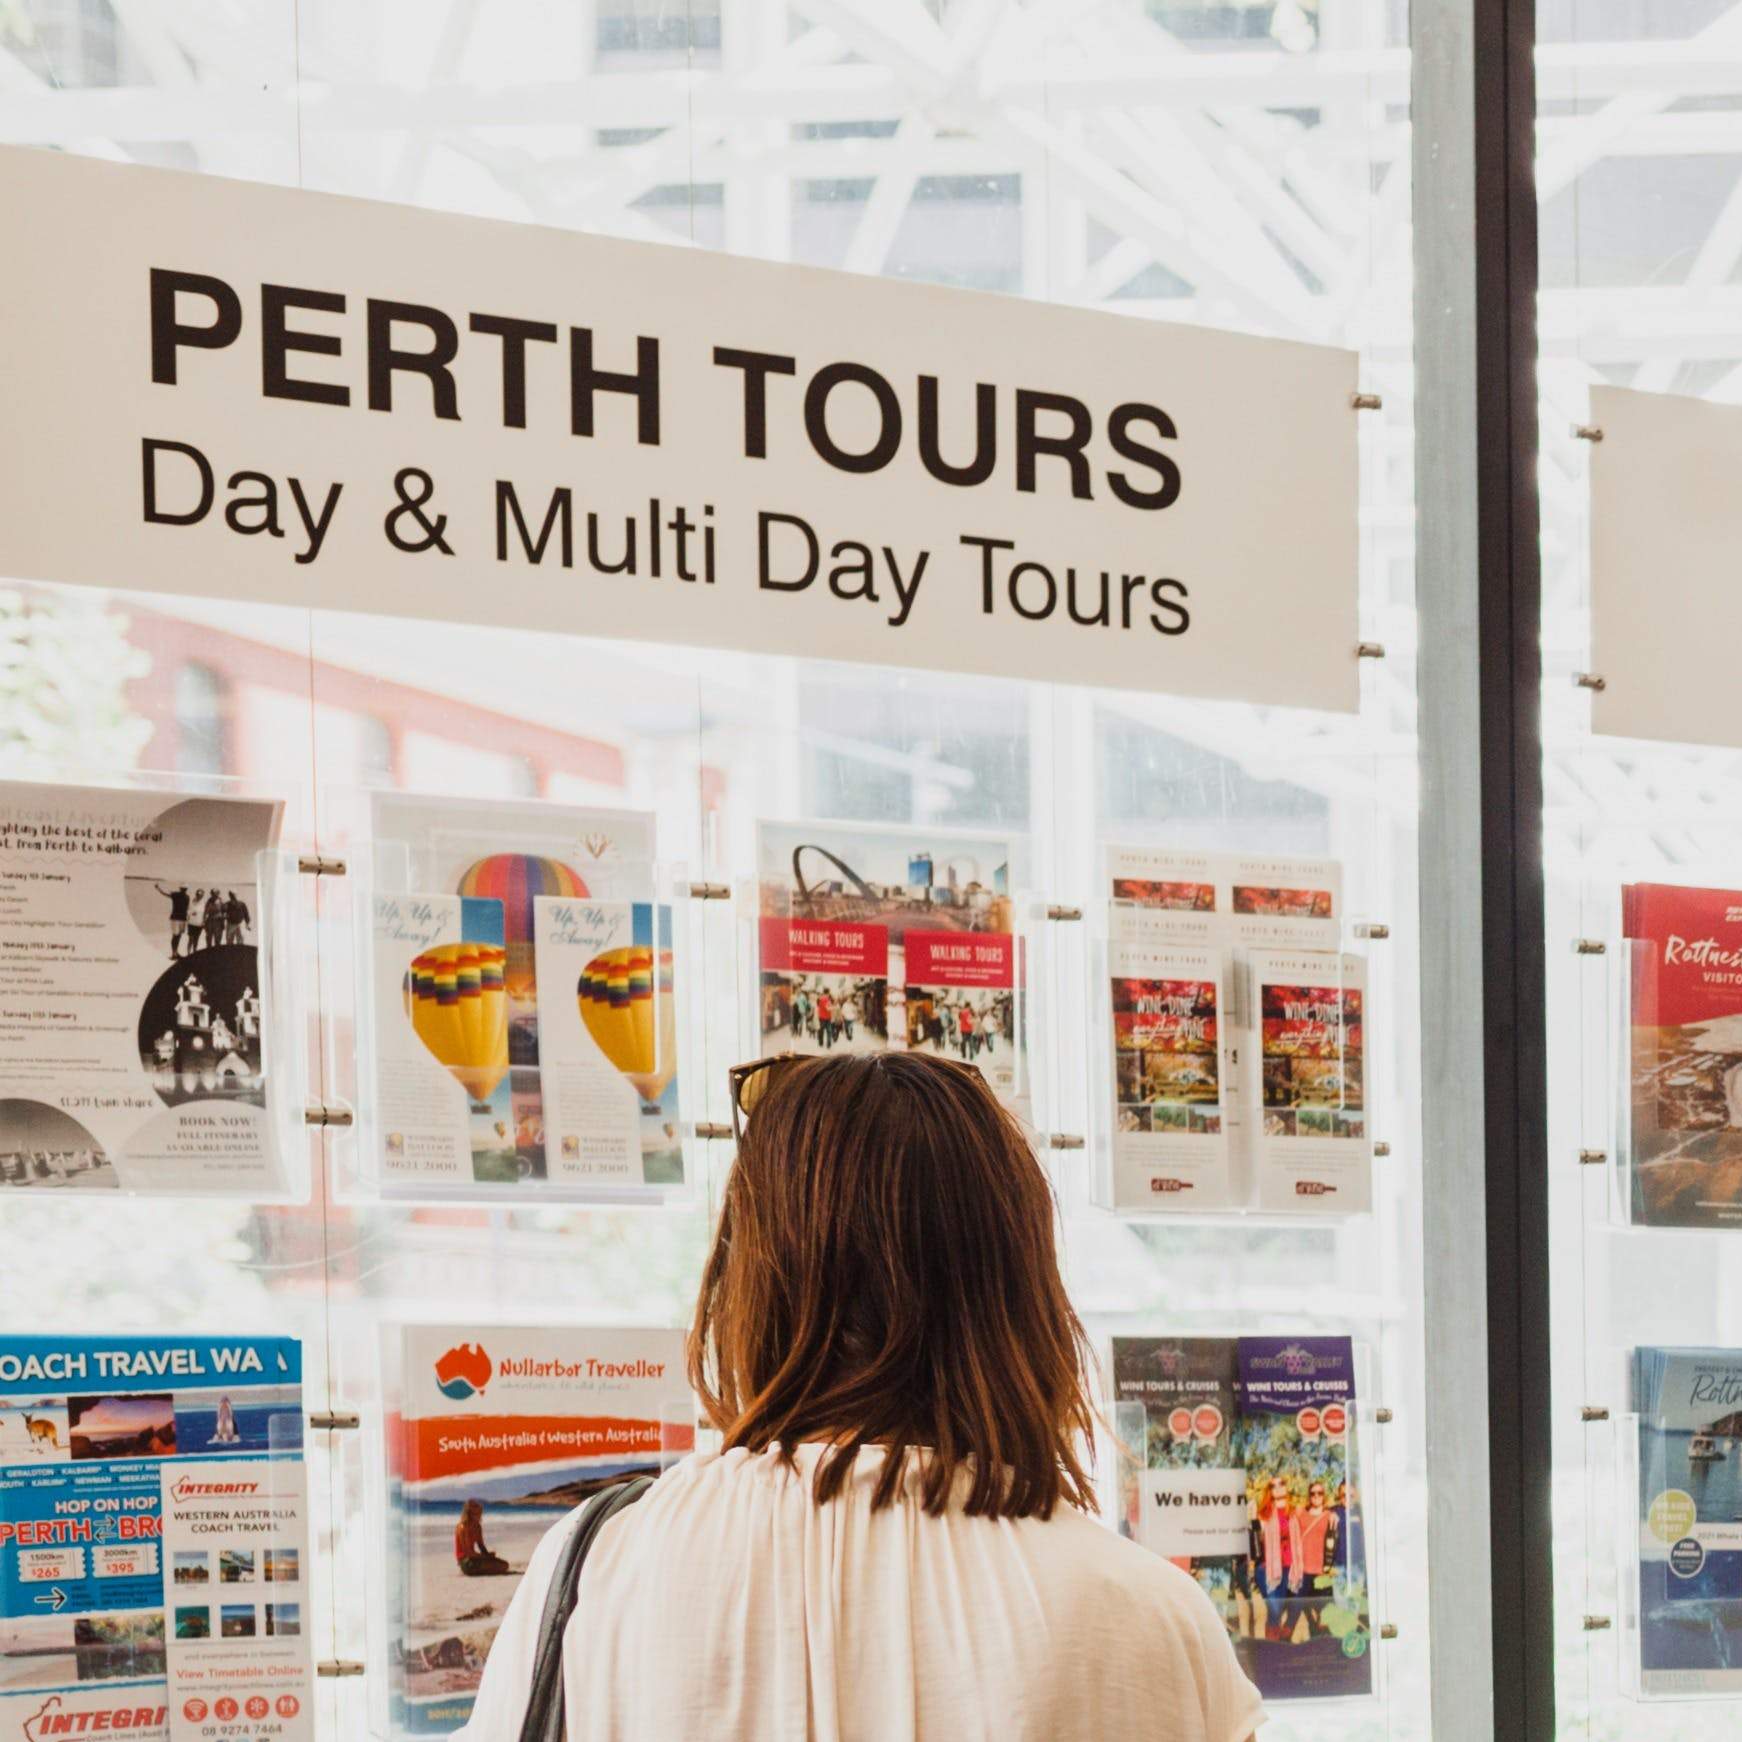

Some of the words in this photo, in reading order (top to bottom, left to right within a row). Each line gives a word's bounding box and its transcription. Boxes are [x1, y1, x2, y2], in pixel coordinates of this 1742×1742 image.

[150, 266, 661, 447] PERTH
[713, 346, 1184, 511] TOURS
[142, 437, 343, 564] Day
[383, 467, 455, 556] &
[494, 480, 717, 585] Multi
[758, 511, 930, 627] Day
[960, 535, 1190, 636] Tours
[66, 825, 93, 839] best
[111, 830, 130, 841] the
[17, 839, 41, 850] from
[45, 840, 78, 851] Perth
[789, 930, 830, 947] WALKING
[835, 932, 865, 949] TOURS
[930, 945, 971, 961] WALKING
[975, 947, 1003, 963] TOURS
[179, 1116, 216, 1127] BOOK
[94, 1350, 206, 1377] TRAVEL
[210, 1347, 264, 1372] WA
[500, 1358, 582, 1378] Nullarbor
[586, 1358, 665, 1378] Traveller
[1120, 1381, 1144, 1392] WINE
[1146, 1381, 1176, 1392] TOURS
[1186, 1381, 1220, 1392] CRUISES
[1247, 1381, 1271, 1392] WINE
[1273, 1381, 1302, 1392] TOURS
[1313, 1380, 1349, 1392] CRUISES
[439, 1436, 476, 1452] South
[478, 1431, 537, 1448] Australia
[548, 1428, 603, 1446] Western
[178, 1482, 259, 1494] INTEGRITY
[55, 1499, 90, 1514] HOP
[94, 1498, 120, 1512] ON
[123, 1496, 158, 1510] HOP
[1155, 1492, 1182, 1507] We
[1189, 1491, 1231, 1507] have
[173, 1511, 229, 1521] WESTERN
[0, 1517, 92, 1547] PERTH
[191, 1523, 233, 1534] COACH
[32, 1567, 60, 1579] $265
[106, 1563, 134, 1575] $395
[176, 1669, 204, 1680] View
[208, 1666, 263, 1678] Timetable
[267, 1665, 304, 1676] Online
